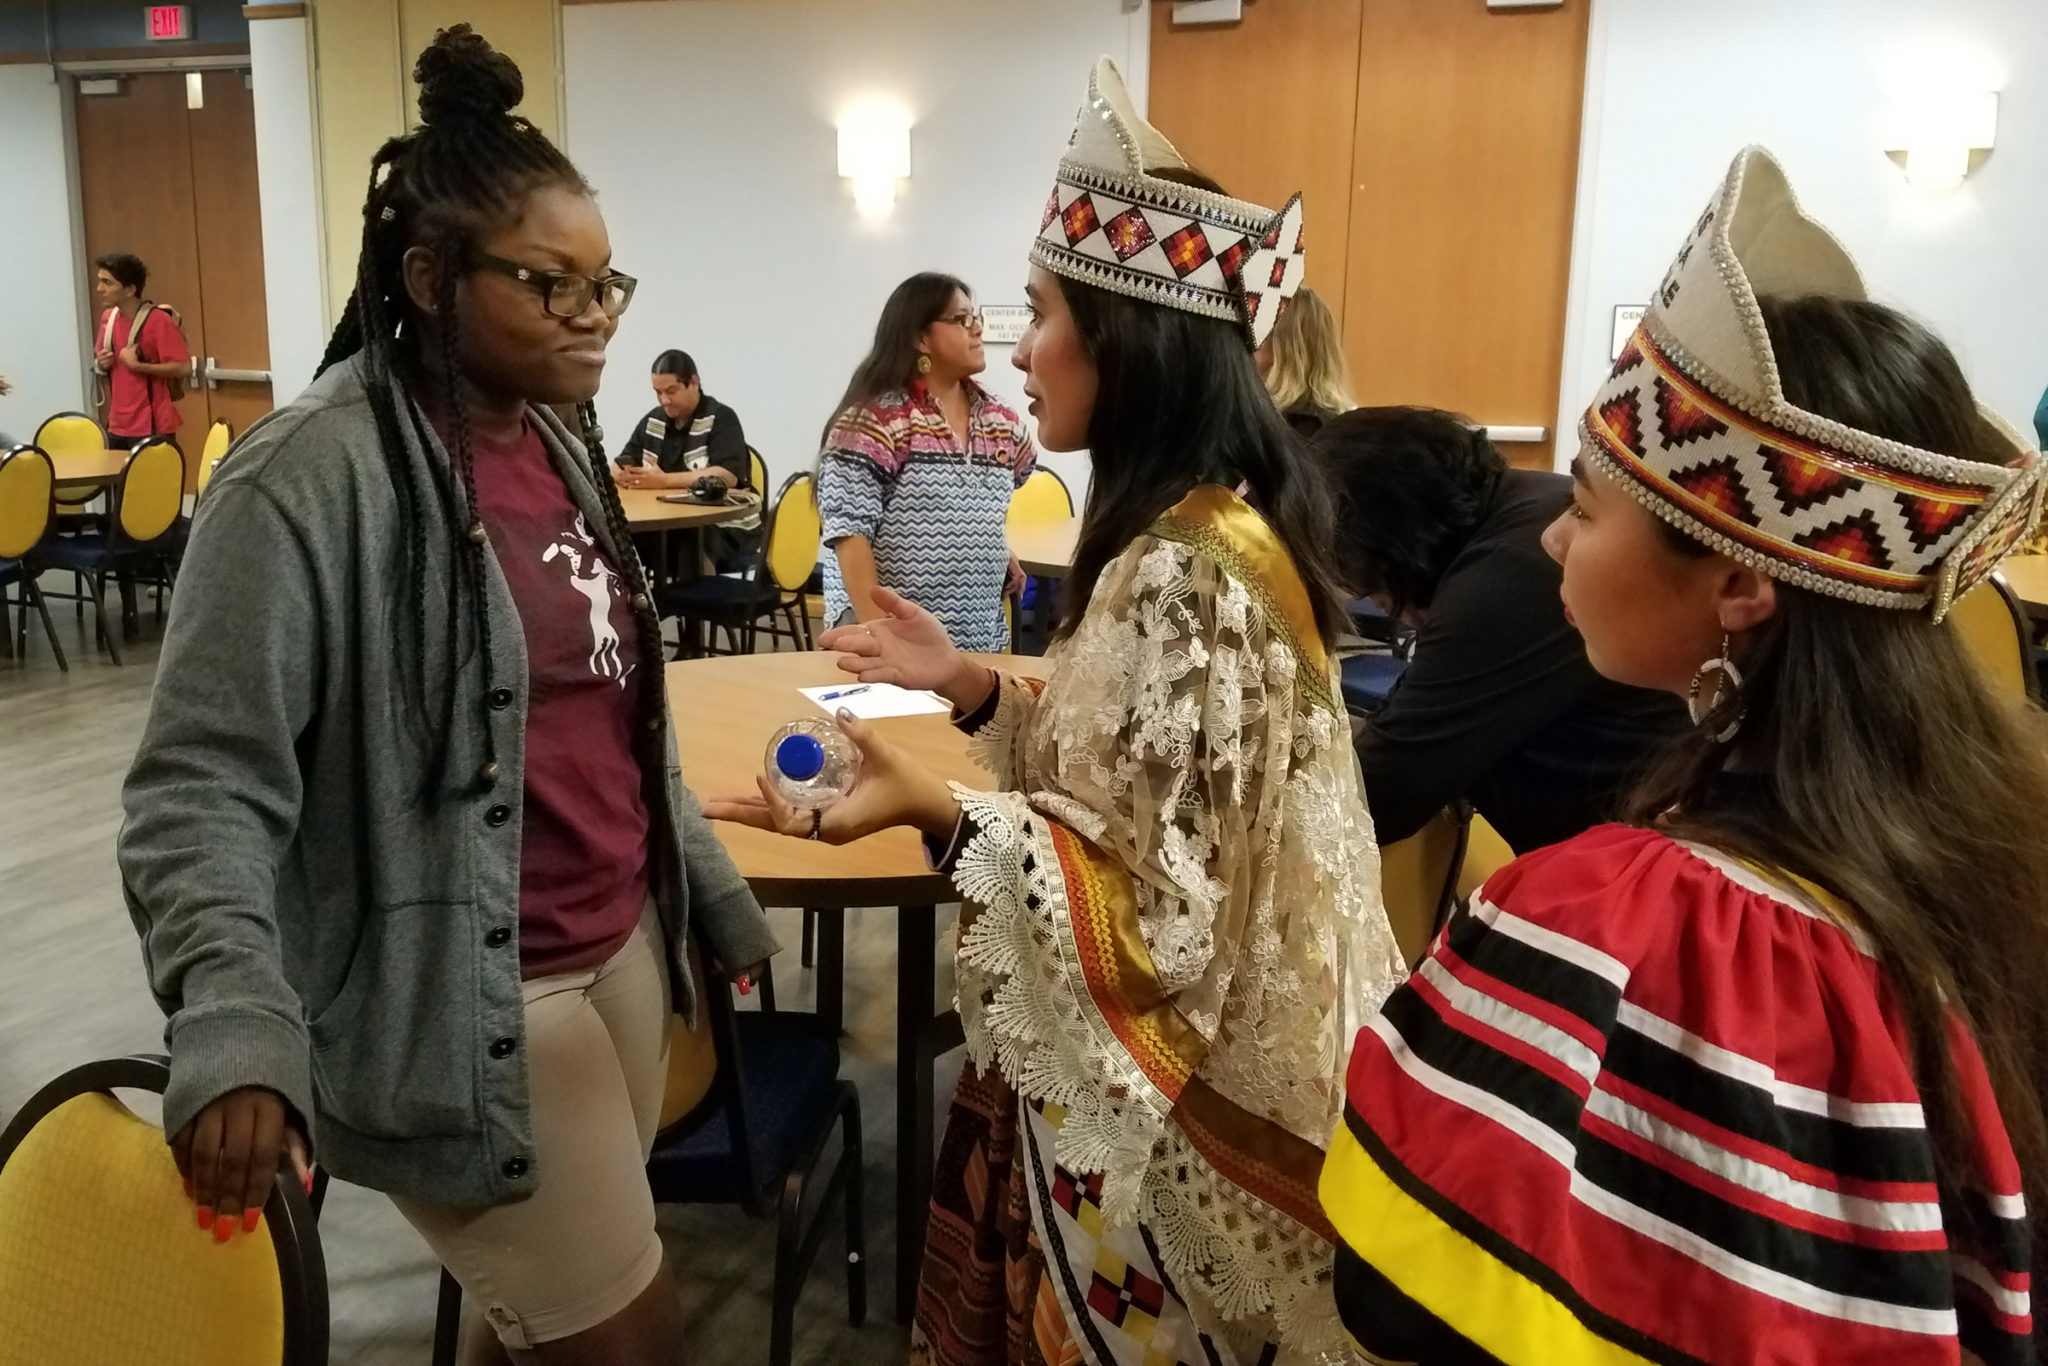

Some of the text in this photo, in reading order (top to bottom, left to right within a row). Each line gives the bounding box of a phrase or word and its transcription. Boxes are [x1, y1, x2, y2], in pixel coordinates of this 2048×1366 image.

[153, 8, 180, 36] EXIT
[985, 309, 1016, 317] CENTER
[1621, 311, 1644, 320] CEN
